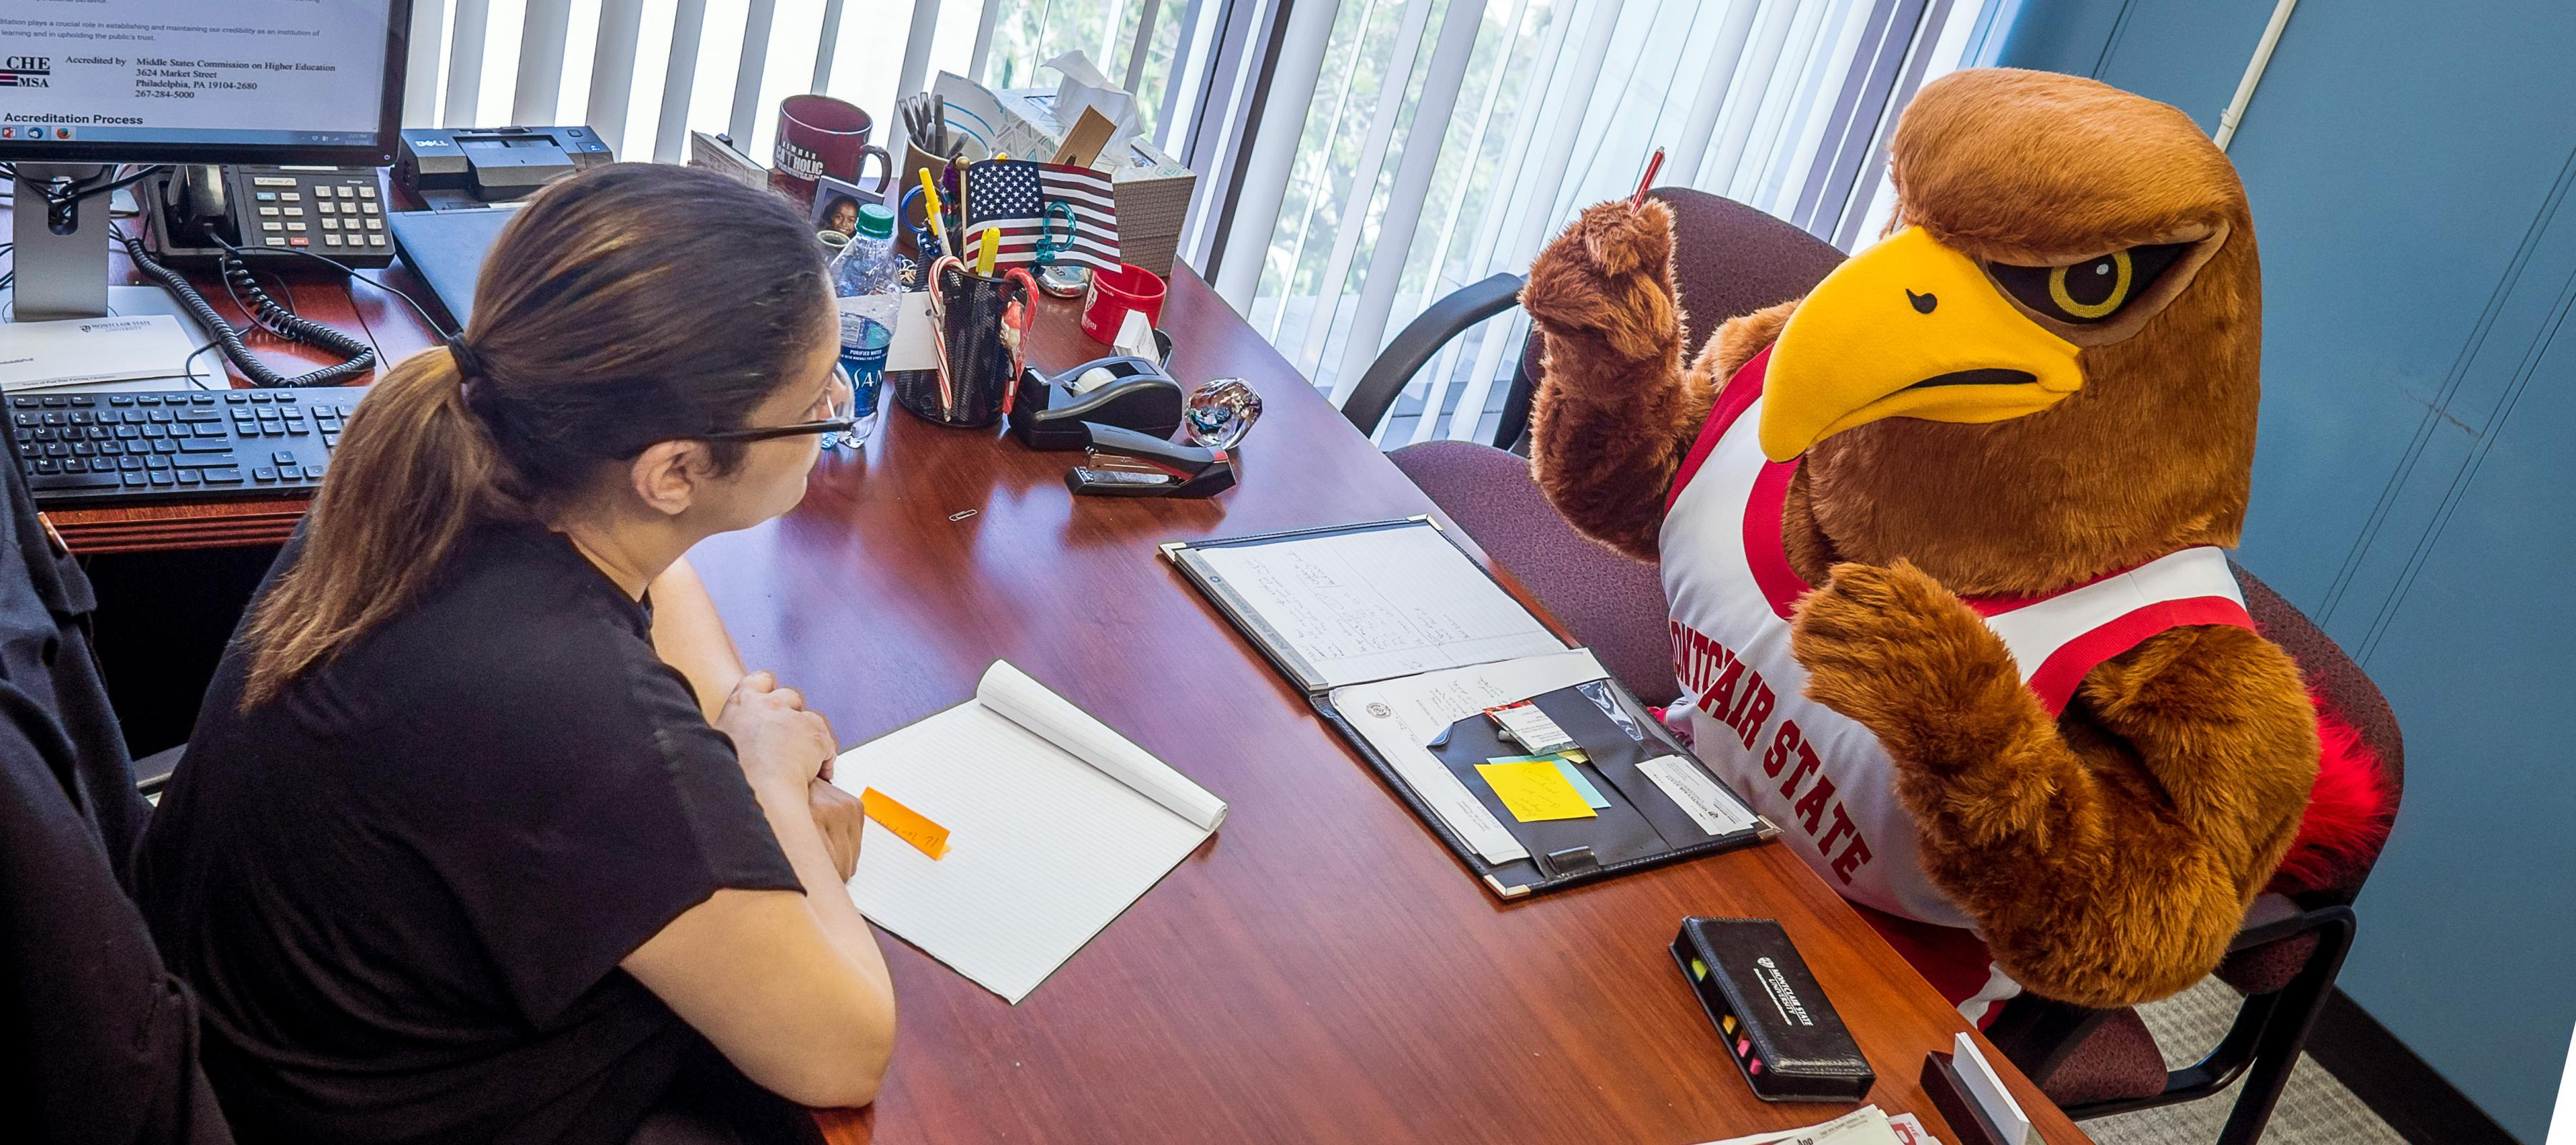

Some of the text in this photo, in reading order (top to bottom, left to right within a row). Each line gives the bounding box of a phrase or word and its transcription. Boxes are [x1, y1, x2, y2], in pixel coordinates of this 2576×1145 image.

[116, 58, 126, 67] by
[137, 58, 167, 67] Middle
[170, 59, 195, 67] States
[197, 59, 249, 69] Commission
[265, 62, 292, 71] Higher
[19, 77, 49, 87] MSA
[136, 79, 190, 89] Philadelphia,
[209, 81, 257, 89] 19104-2680
[4, 112, 143, 125] Accreditation Process
[776, 145, 824, 176] CATHOLIC
[1670, 620, 1873, 886] ONTCAIR STATE
[1680, 786, 1707, 812] MONTCLAIR
[1768, 978, 1797, 1015] UNIVERSITY
[1771, 968, 1802, 1007] MONTCLAIR
[1795, 1006, 1814, 1026] STATE
